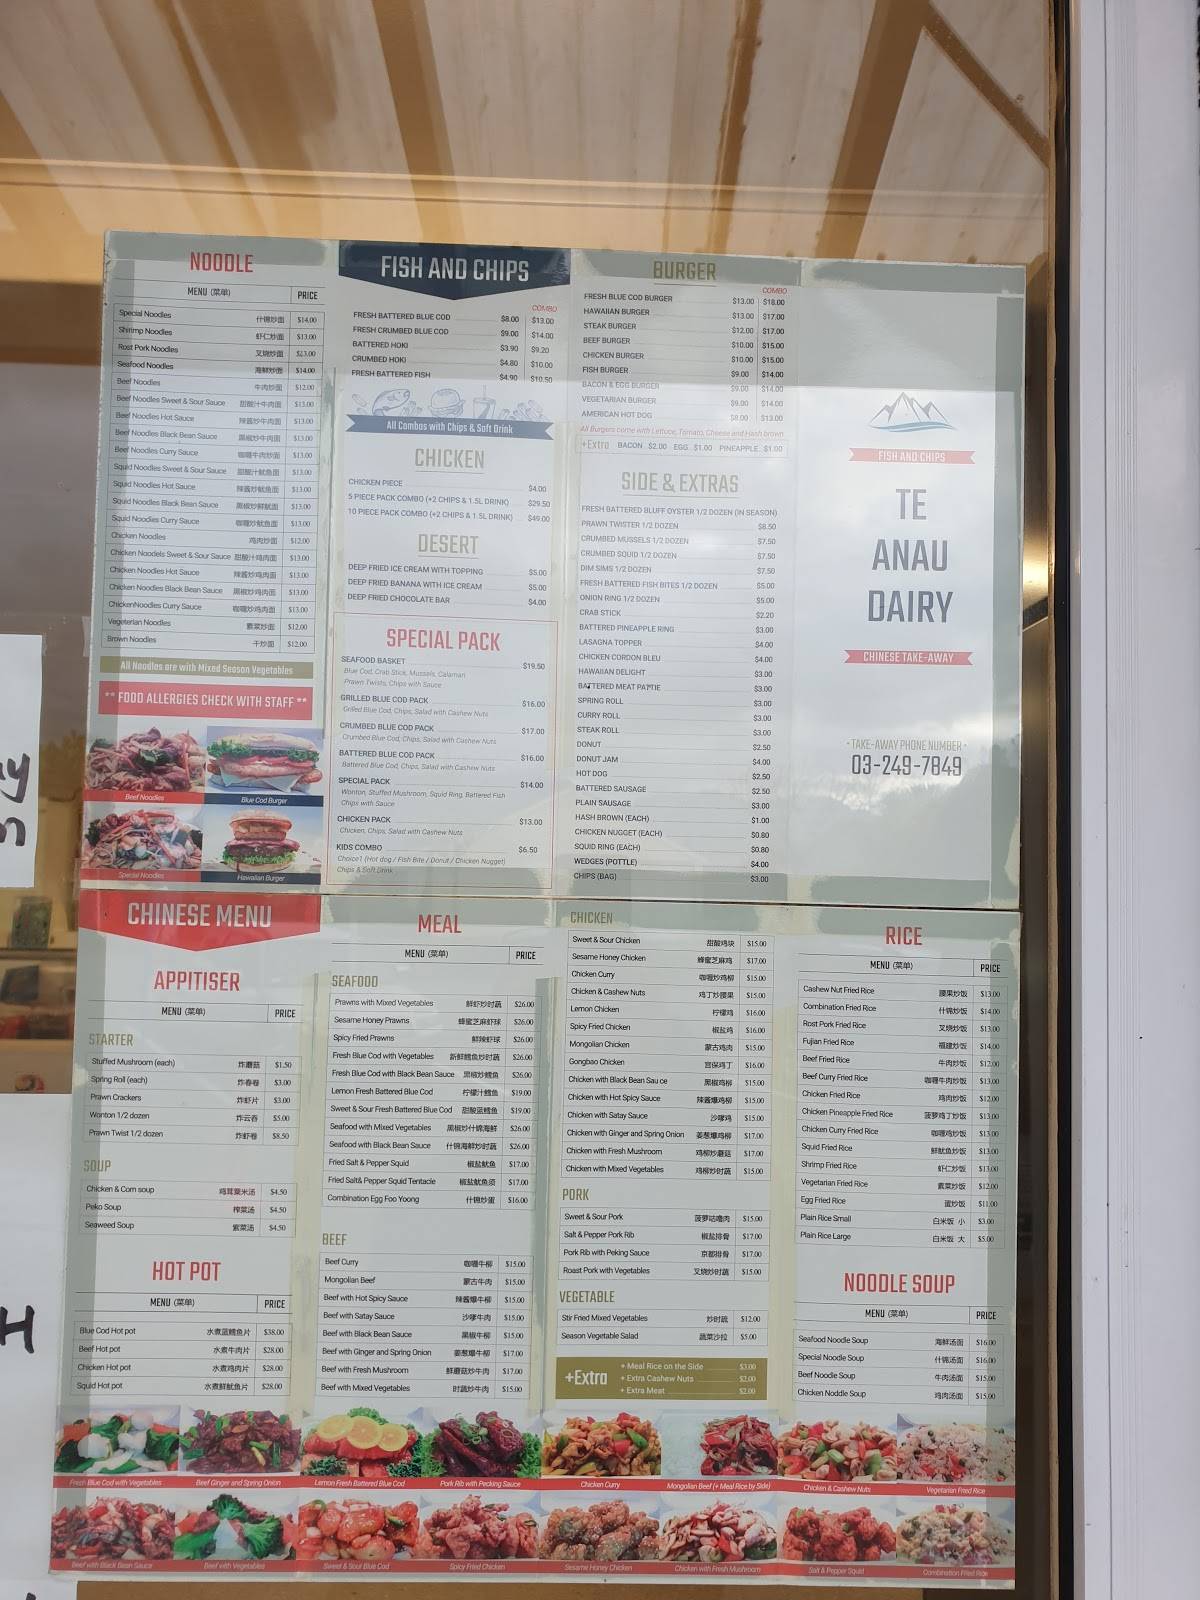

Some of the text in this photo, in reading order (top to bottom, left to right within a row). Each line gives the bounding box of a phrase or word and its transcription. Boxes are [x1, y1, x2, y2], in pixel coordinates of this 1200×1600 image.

[190, 251, 253, 272] NOODLE
[381, 255, 529, 282] FISH AND CHIPS
[653, 261, 716, 280] BURGER
[188, 287, 208, 296] MENU
[297, 291, 318, 300] PRICE
[762, 287, 787, 295] COMBO
[733, 297, 754, 305] $13.00
[119, 309, 171, 318] Special Noodles
[378, 312, 415, 320] BATTERED
[532, 317, 554, 325] $13.00
[621, 308, 650, 316] BURGER
[732, 312, 754, 320] $13.00
[117, 361, 145, 369] Seafood
[387, 421, 512, 434] All Combos with Chips & Soft Drink
[415, 448, 485, 468] CHICKEN
[622, 471, 739, 493] SIDE & EXTRAS
[896, 488, 926, 520] TE
[418, 534, 479, 554] DESERT
[872, 539, 949, 572] ANAU
[348, 593, 366, 601] DEEP
[390, 595, 434, 603] CHOCOLATE
[435, 596, 450, 604] BAR
[868, 590, 953, 623] DAIRY
[386, 628, 500, 651] SPECIAL PACK
[341, 656, 376, 664] SEAFOOD
[377, 657, 405, 665] BASKET
[864, 651, 954, 663] CHINESE TAKE-AWAY
[118, 692, 294, 708] FOOD ALLERGIES CHECK WITH STAFF
[851, 739, 962, 751] TAKE-AWAY PHONE NUMBER
[852, 754, 962, 776] 03-249-7849
[241, 796, 254, 804] Blue
[268, 797, 288, 806] Burger
[355, 844, 382, 852] COMBO
[519, 846, 537, 854] $6.50
[605, 858, 637, 866] (POTTLE)
[128, 902, 272, 928] CHINESE MENU
[571, 911, 613, 924] CHICKEN
[418, 914, 462, 933] MEAL
[885, 926, 922, 946] RICE
[405, 949, 425, 958] MENU
[516, 951, 536, 960] PRICE
[153, 970, 240, 992] APPITISER
[332, 975, 378, 988] SEAFOOD
[89, 1033, 133, 1047] STARTER
[333, 1034, 351, 1042] Spicy
[352, 1034, 369, 1042] Fried
[836, 1056, 850, 1064] Rice
[91, 1076, 112, 1085] Spring
[127, 1076, 148, 1085] (each)
[274, 1079, 291, 1087] $3.00
[84, 1160, 111, 1172] SOUP
[562, 1188, 589, 1201] PORK
[322, 1233, 347, 1246] BEEF
[152, 1261, 221, 1281] HOT POT
[325, 1276, 375, 1284] Mongolian Beef
[844, 1273, 955, 1293] NOODLE SOUP
[559, 1291, 615, 1303] VEGETABLE
[111, 1327, 123, 1335] Hot
[125, 1328, 136, 1336] pot
[264, 1328, 284, 1336] $38.00
[850, 1390, 866, 1398] Soup
[976, 1392, 995, 1400] $15.00
